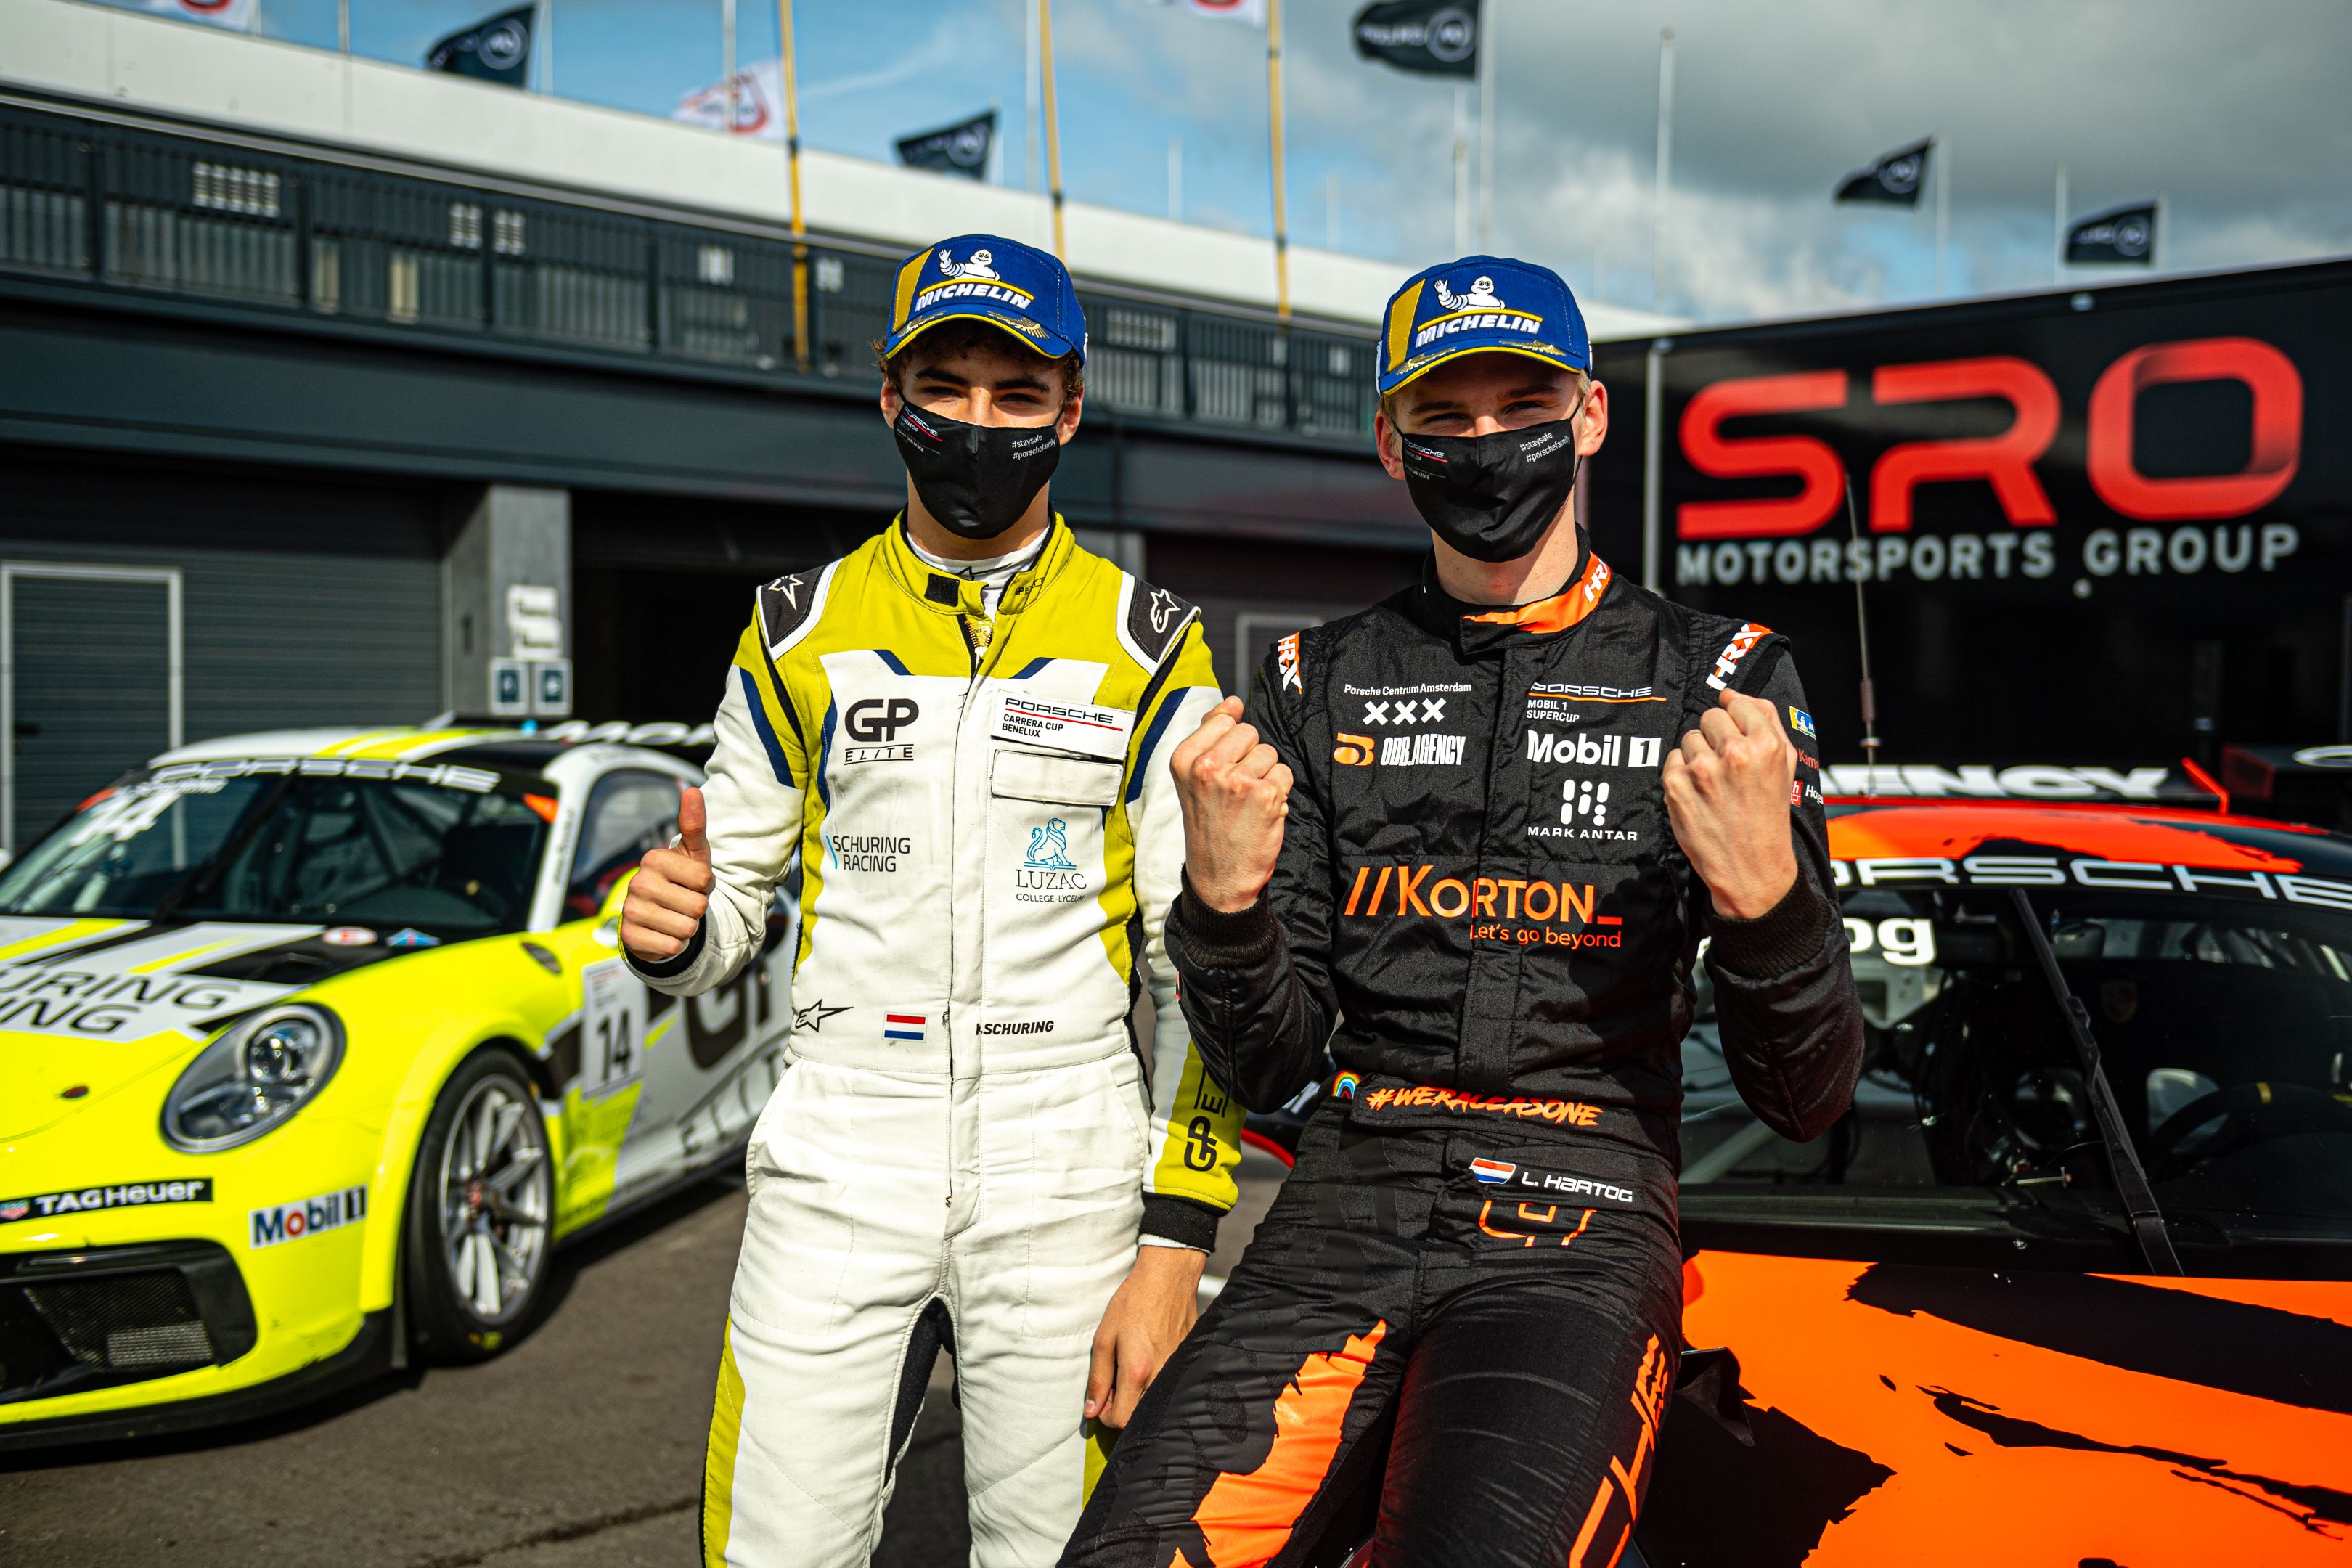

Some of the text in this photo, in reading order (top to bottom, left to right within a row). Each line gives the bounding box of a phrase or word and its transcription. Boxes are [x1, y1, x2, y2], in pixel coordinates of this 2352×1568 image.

[915, 284, 1032, 311] MICHELIN
[1416, 314, 1540, 348] MICHELIN
[904, 406, 939, 437] PORSCHE
[1011, 434, 1042, 449] #staysafe
[1519, 432, 1553, 452] #staysafe
[1676, 335, 2304, 539] SRO
[1013, 438, 1056, 460] #porschefamily
[1404, 438, 1445, 459] PORSCHE
[1526, 436, 1570, 462] #porschefamily
[1675, 523, 2300, 585] MOTORSPORTS GROUP
[1278, 634, 1302, 692] HRX
[1344, 682, 1471, 695] Porsche Centrum Amsterdam
[1530, 682, 1652, 698] PORSCHE
[1005, 698, 1113, 724] PORSCHE
[1526, 709, 1580, 723] SUPERCUP
[1527, 699, 1567, 711] MOBIL 1
[844, 698, 919, 742] GP
[1002, 723, 1041, 738] BENELUX
[1003, 714, 1063, 732] CARRERA CUP
[844, 746, 914, 763] ELITE
[1527, 730, 1622, 767] Mobil
[150, 758, 502, 793] PORSCHE
[1527, 826, 1638, 841] MARK ANTAR
[833, 836, 910, 854] SCHURING
[843, 854, 897, 872] RACING
[1016, 869, 1087, 889] LUZAC
[1516, 928, 1540, 946] go
[1545, 926, 1622, 950] beyond
[597, 1006, 633, 1083] 14
[1184, 1115, 1217, 1172] GP
[1521, 1171, 1538, 1187] L.
[253, 1193, 340, 1246] Mobil
